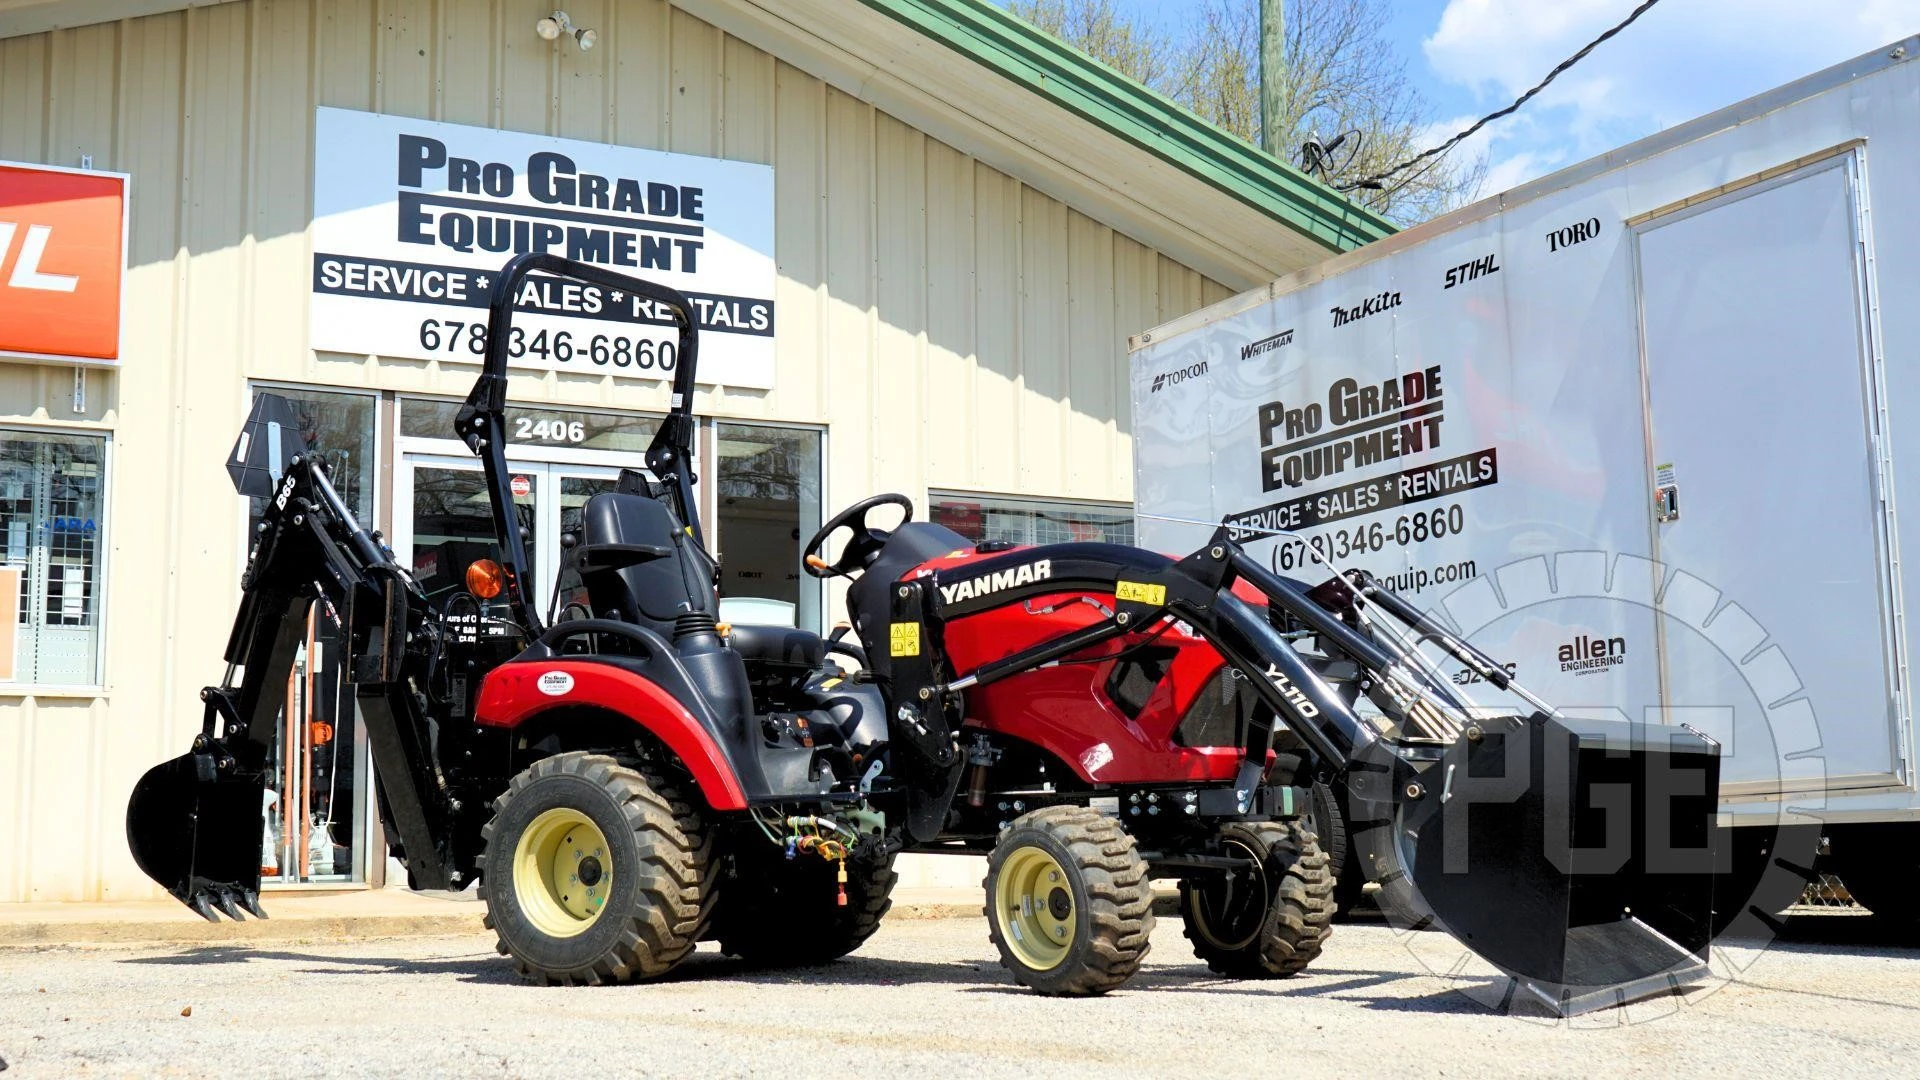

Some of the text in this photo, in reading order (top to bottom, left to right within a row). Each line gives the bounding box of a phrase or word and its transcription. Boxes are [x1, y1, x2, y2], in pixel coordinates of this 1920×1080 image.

[398, 133, 704, 221] PRO GRADE
[398, 201, 704, 274] EQUIPMENT
[1545, 217, 1601, 253] TORO
[1444, 253, 1500, 290] STIHL
[320, 262, 769, 331] SERVICE ALES RETALS
[1240, 333, 1294, 361] WHITEMAN
[1166, 361, 1208, 387] TOPCON
[1258, 364, 1443, 449] PRO GRADE
[515, 417, 585, 442] 2406
[1261, 414, 1444, 493] EQUIPMENT
[275, 475, 296, 511] B65
[1228, 455, 1493, 541] SERVICE SALES RENTALS
[1272, 503, 1464, 575] (678)346-6860
[940, 559, 1051, 604] YANMAR
[1558, 635, 1626, 662] allen
[1561, 655, 1624, 672] ENGINEERING
[1265, 663, 1319, 718] YL110
